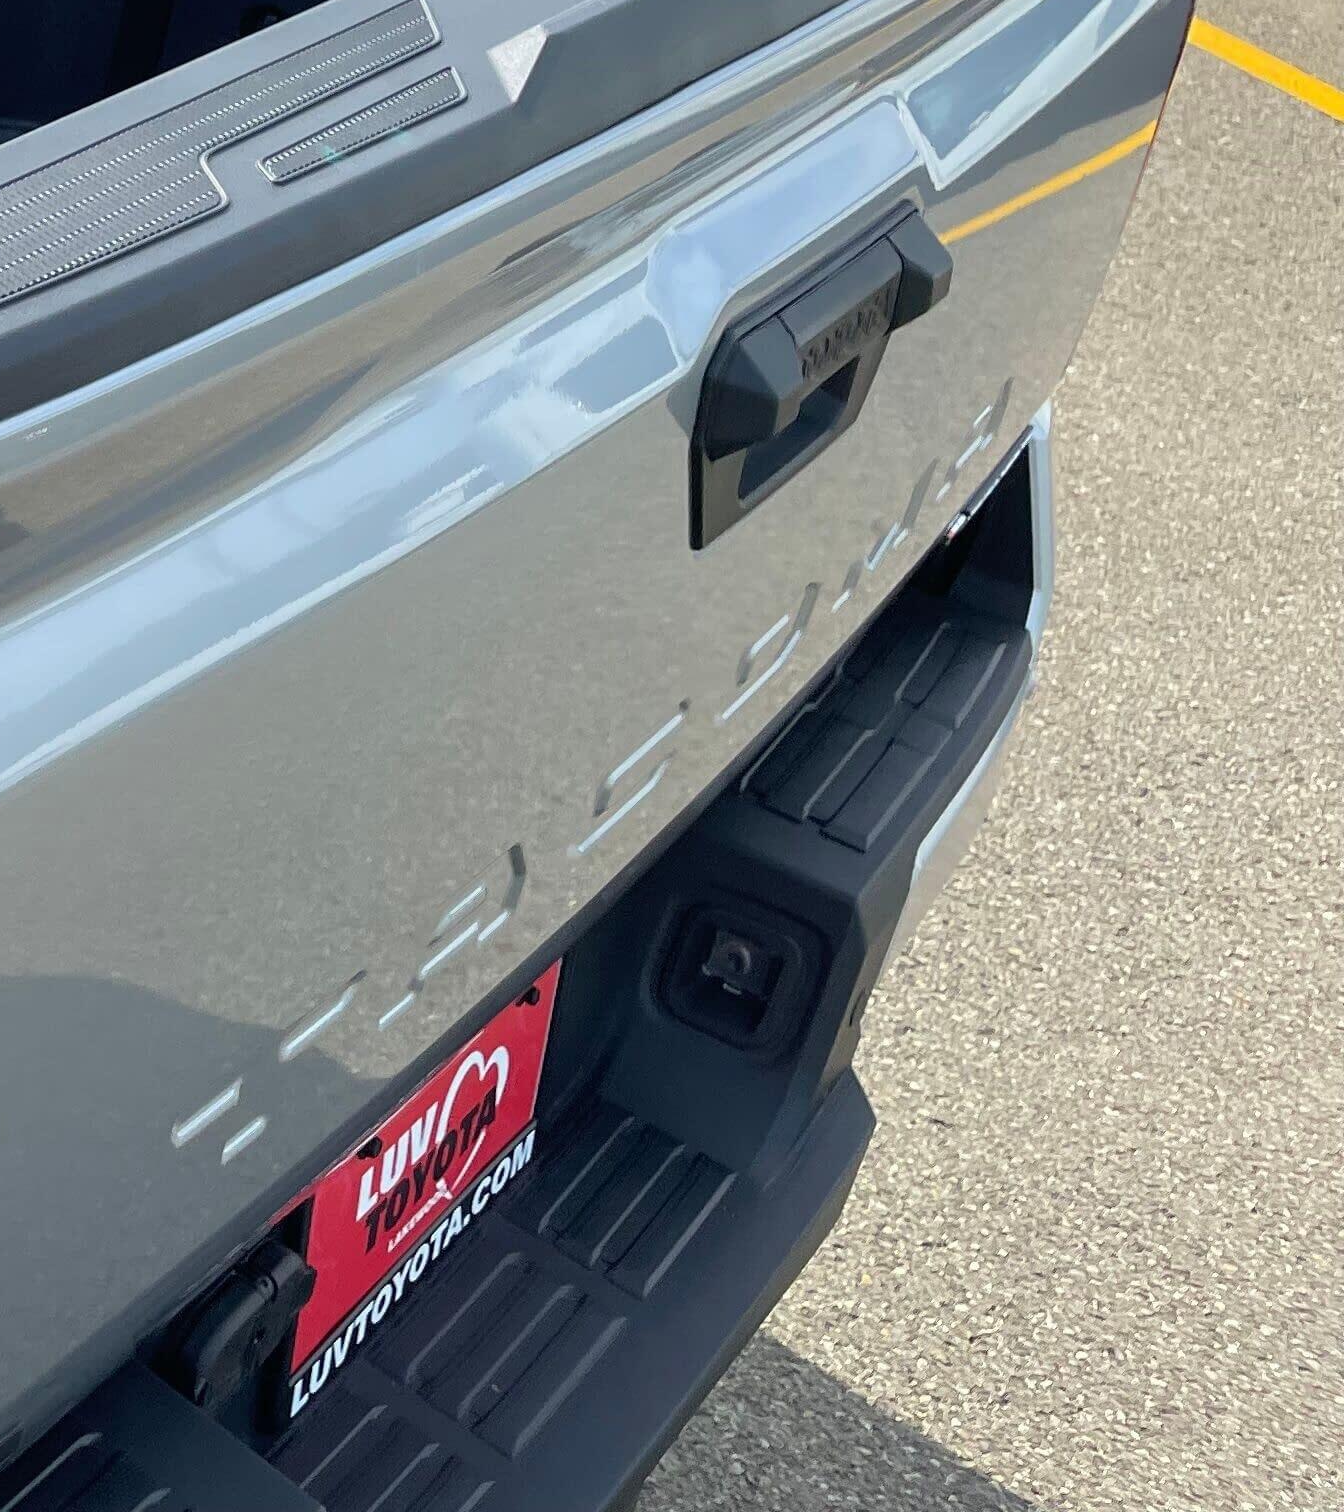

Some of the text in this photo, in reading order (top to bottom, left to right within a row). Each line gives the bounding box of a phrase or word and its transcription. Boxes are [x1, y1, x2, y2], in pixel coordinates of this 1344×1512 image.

[356, 1101, 439, 1222] LUV
[365, 1085, 499, 1253] TOYOTA
[290, 1129, 536, 1418] LUVTOYOTA.COM
